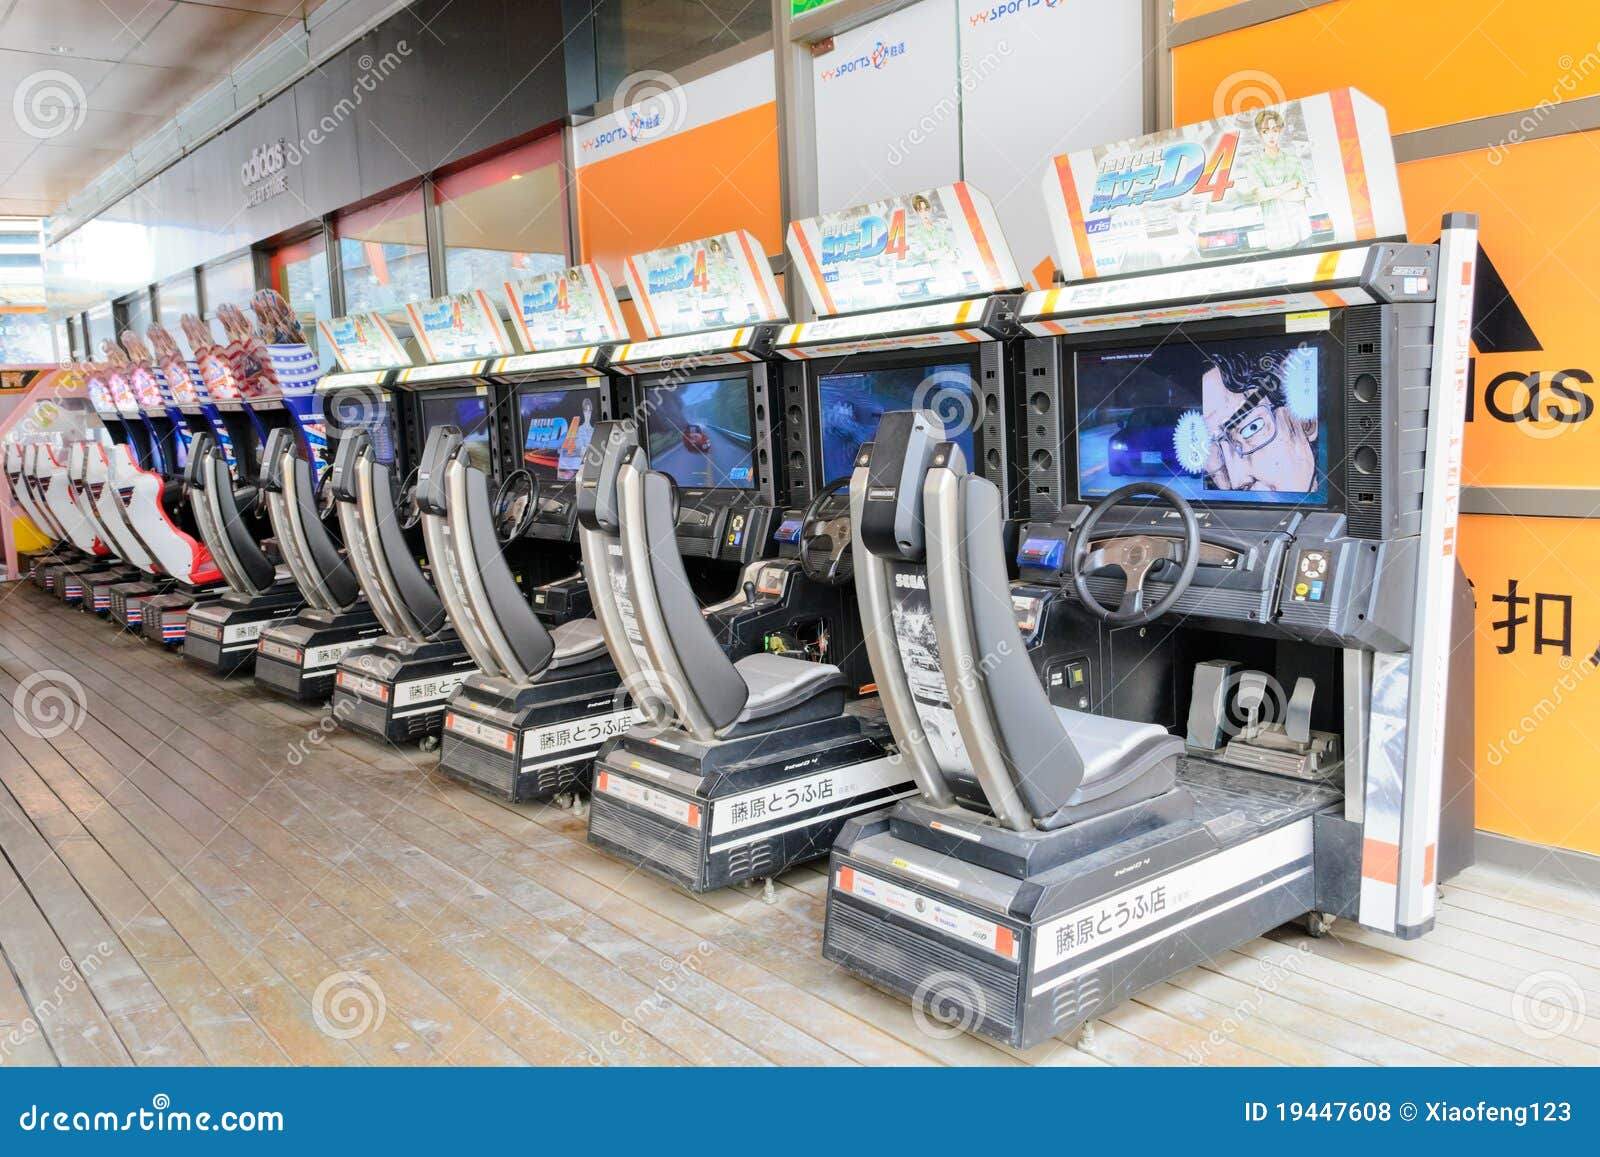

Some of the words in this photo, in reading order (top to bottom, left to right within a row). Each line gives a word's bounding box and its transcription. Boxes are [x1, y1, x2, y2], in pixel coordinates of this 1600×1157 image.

[240, 142, 287, 187] adidas
[895, 572, 927, 590] SEGA
[540, 716, 632, 751] 藤原とうふ店
[731, 779, 833, 824] 藤原とうふ店
[1056, 886, 1166, 956] 藤原とうふ店
